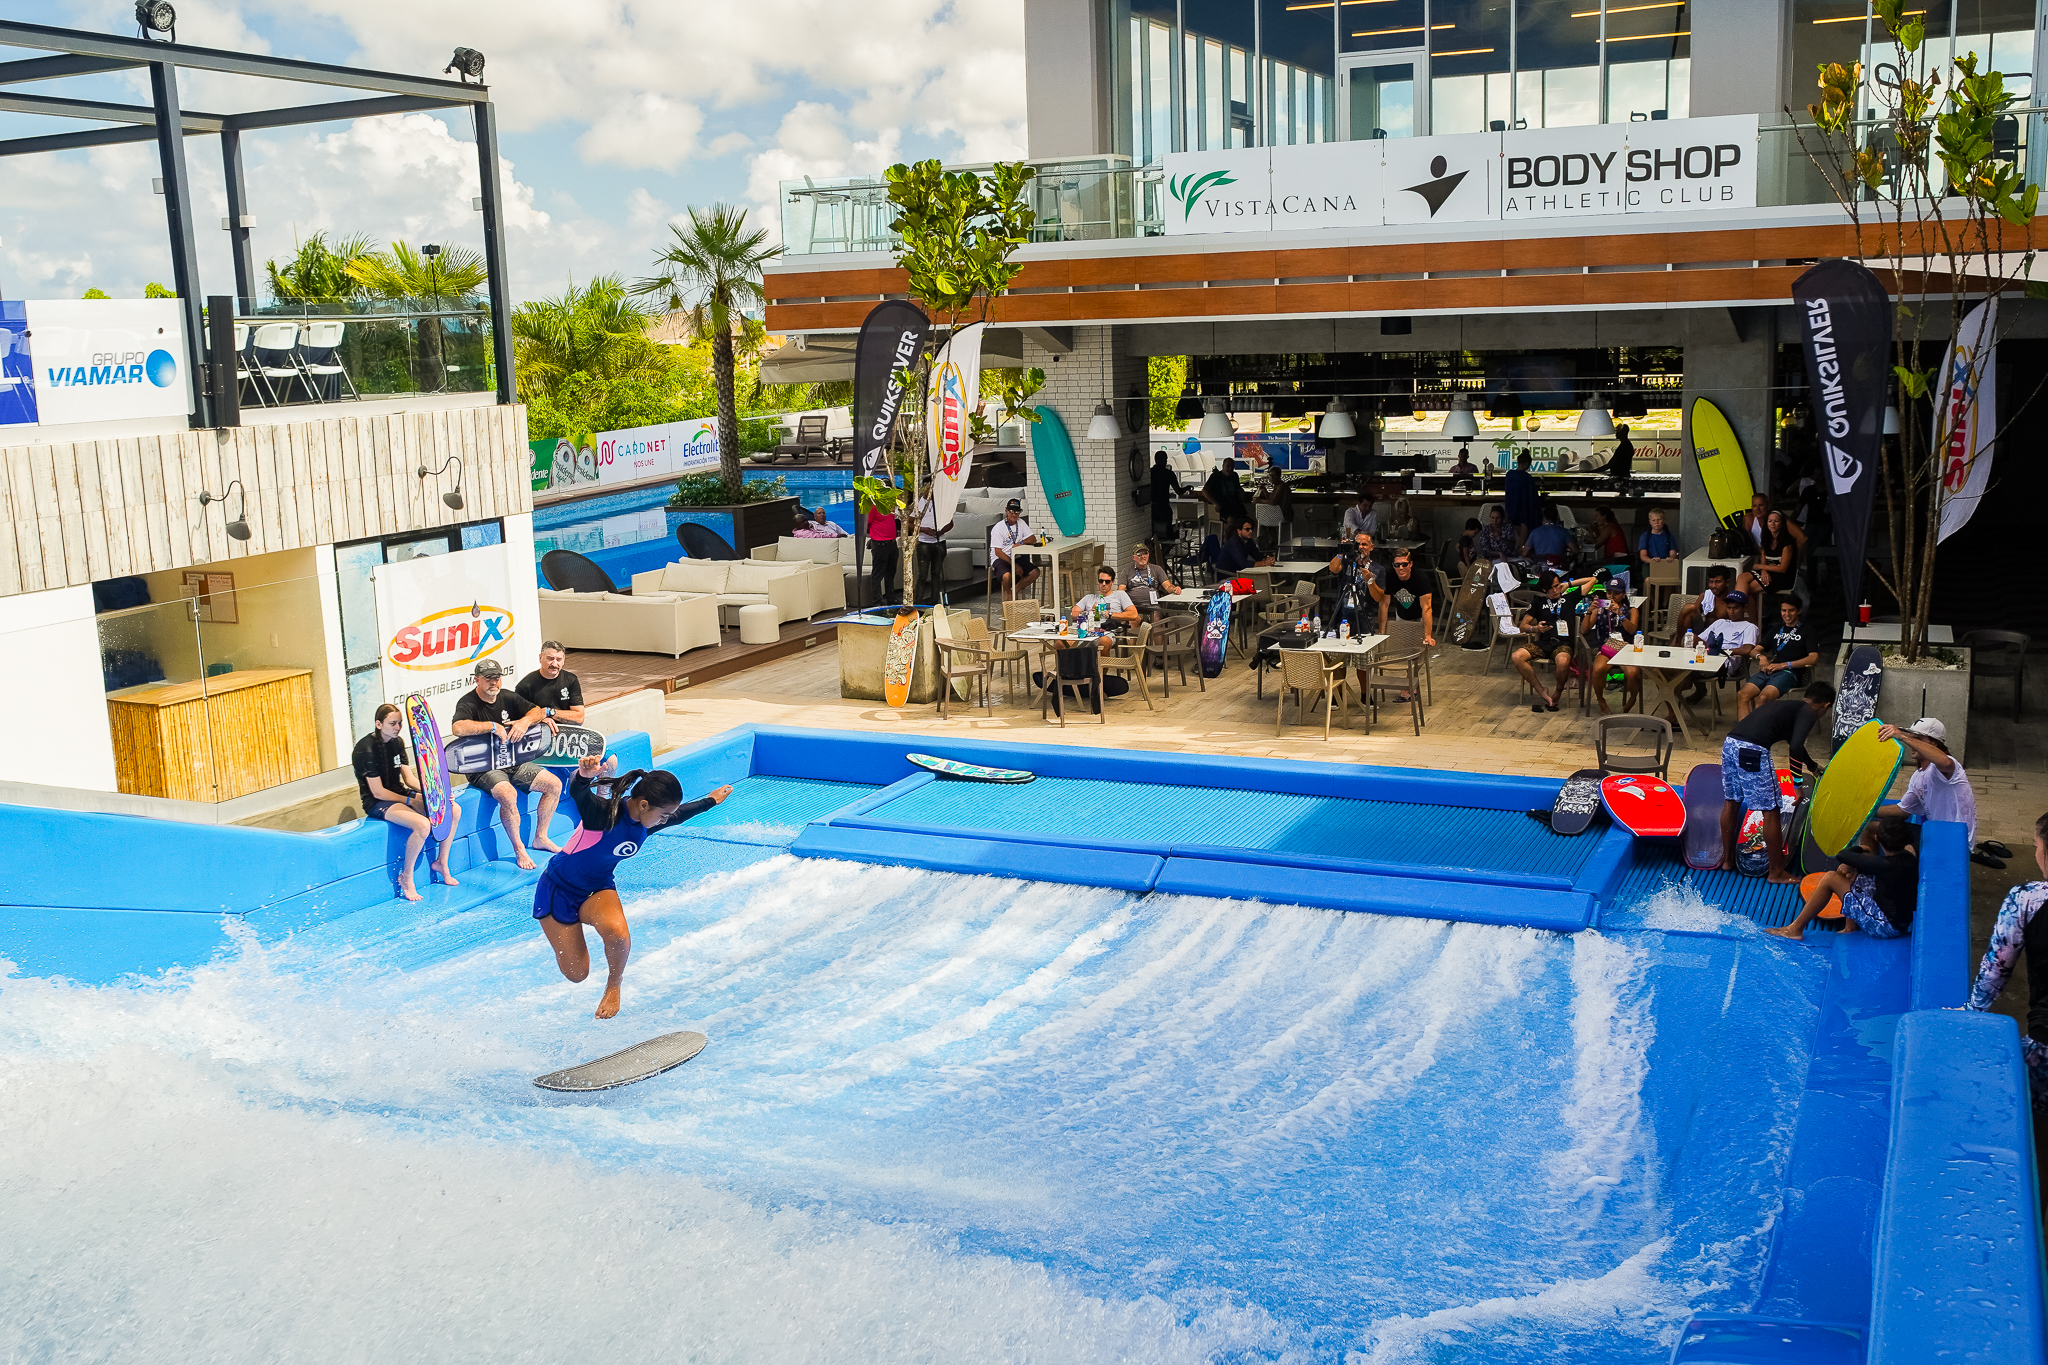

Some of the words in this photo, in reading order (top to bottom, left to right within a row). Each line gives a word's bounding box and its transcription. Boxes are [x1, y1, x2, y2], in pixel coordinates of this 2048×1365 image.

[1507, 151, 1618, 189] BODY
[1626, 143, 1741, 182] SHOP
[1506, 190, 1641, 212] ATHLETIC
[1660, 185, 1734, 204] CLUB
[92, 351, 145, 366] GRUPO
[48, 364, 144, 388] VIAMAR
[938, 372, 966, 477] Sunix
[617, 439, 666, 457] CARDNET
[683, 438, 719, 458] Electrolit
[393, 608, 504, 663] Sunix
